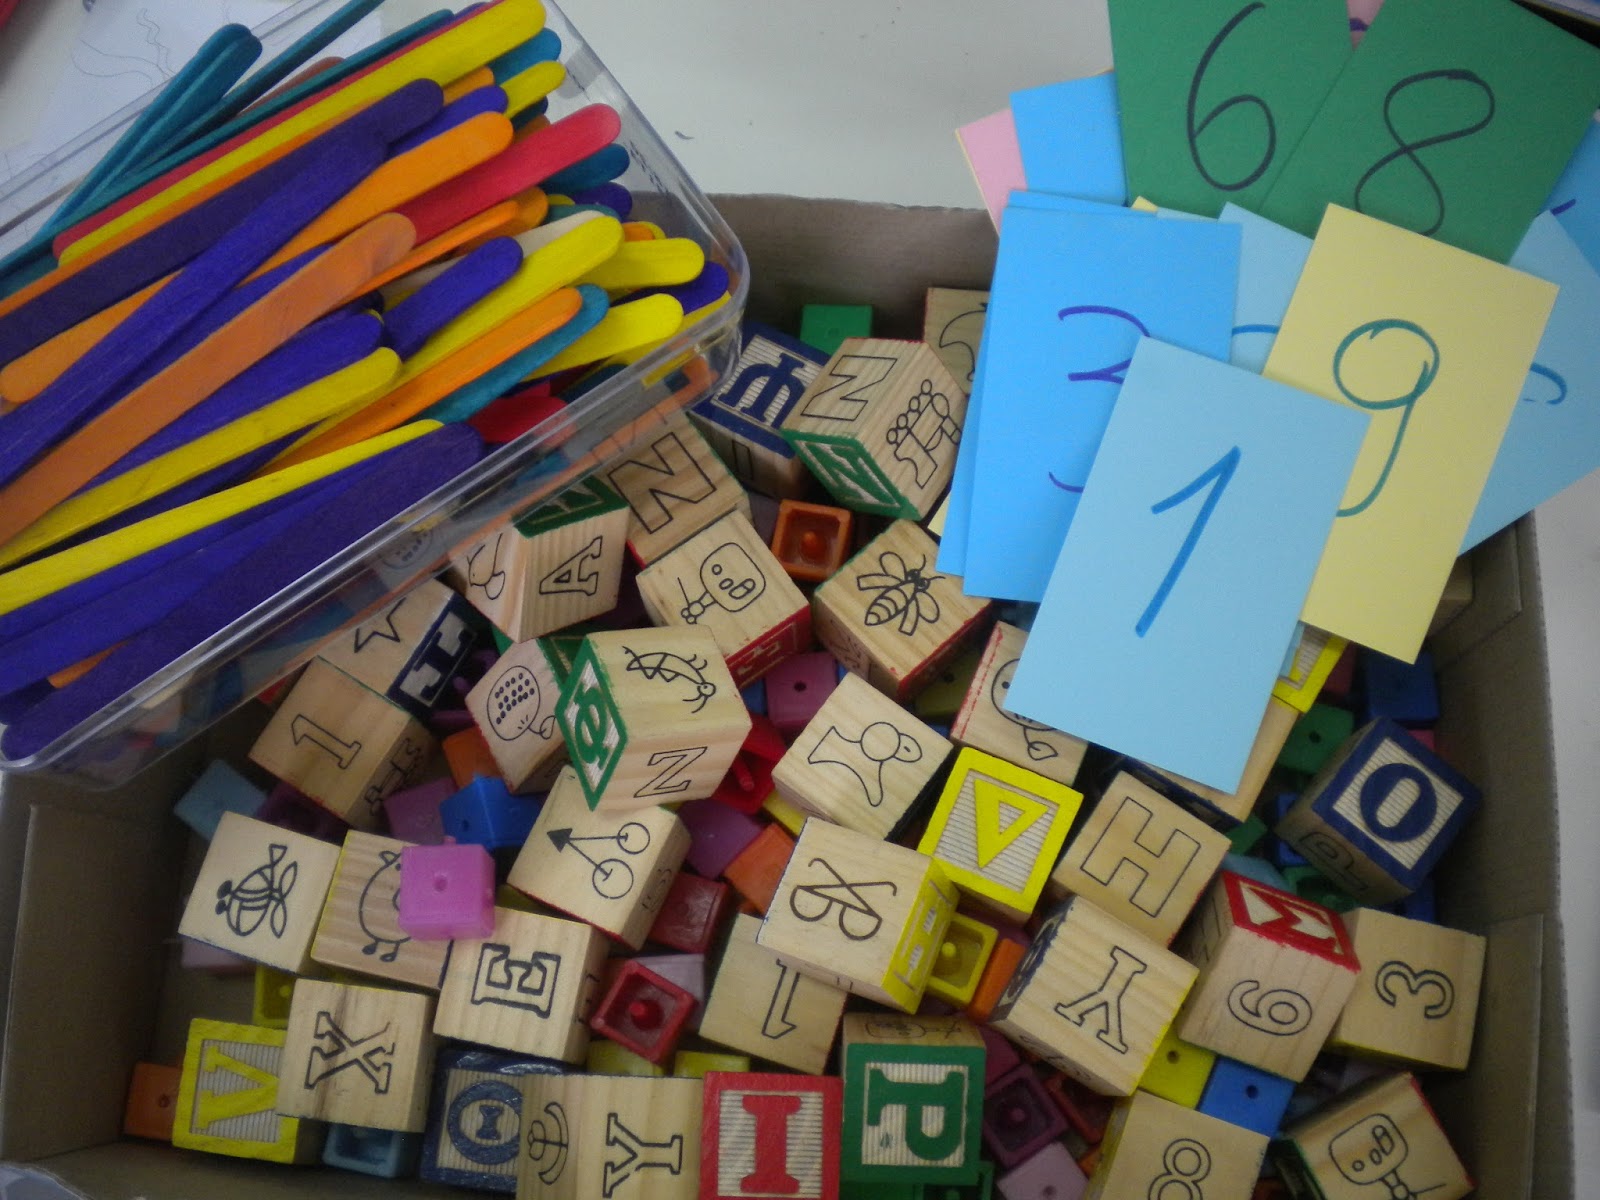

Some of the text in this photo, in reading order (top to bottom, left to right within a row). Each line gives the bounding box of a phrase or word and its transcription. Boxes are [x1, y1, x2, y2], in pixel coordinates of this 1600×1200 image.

[1187, 2, 1277, 192] 6
[1354, 68, 1496, 237] 8
[1333, 318, 1440, 518] 9
[606, 431, 718, 535] N
[539, 535, 604, 596] A
[1135, 445, 1242, 639] 1
[290, 713, 363, 771] 1
[632, 745, 708, 799] Z
[1079, 796, 1202, 918] H
[303, 1010, 393, 1094] X
[602, 1112, 684, 1199] Y
[739, 1094, 802, 1195] I
